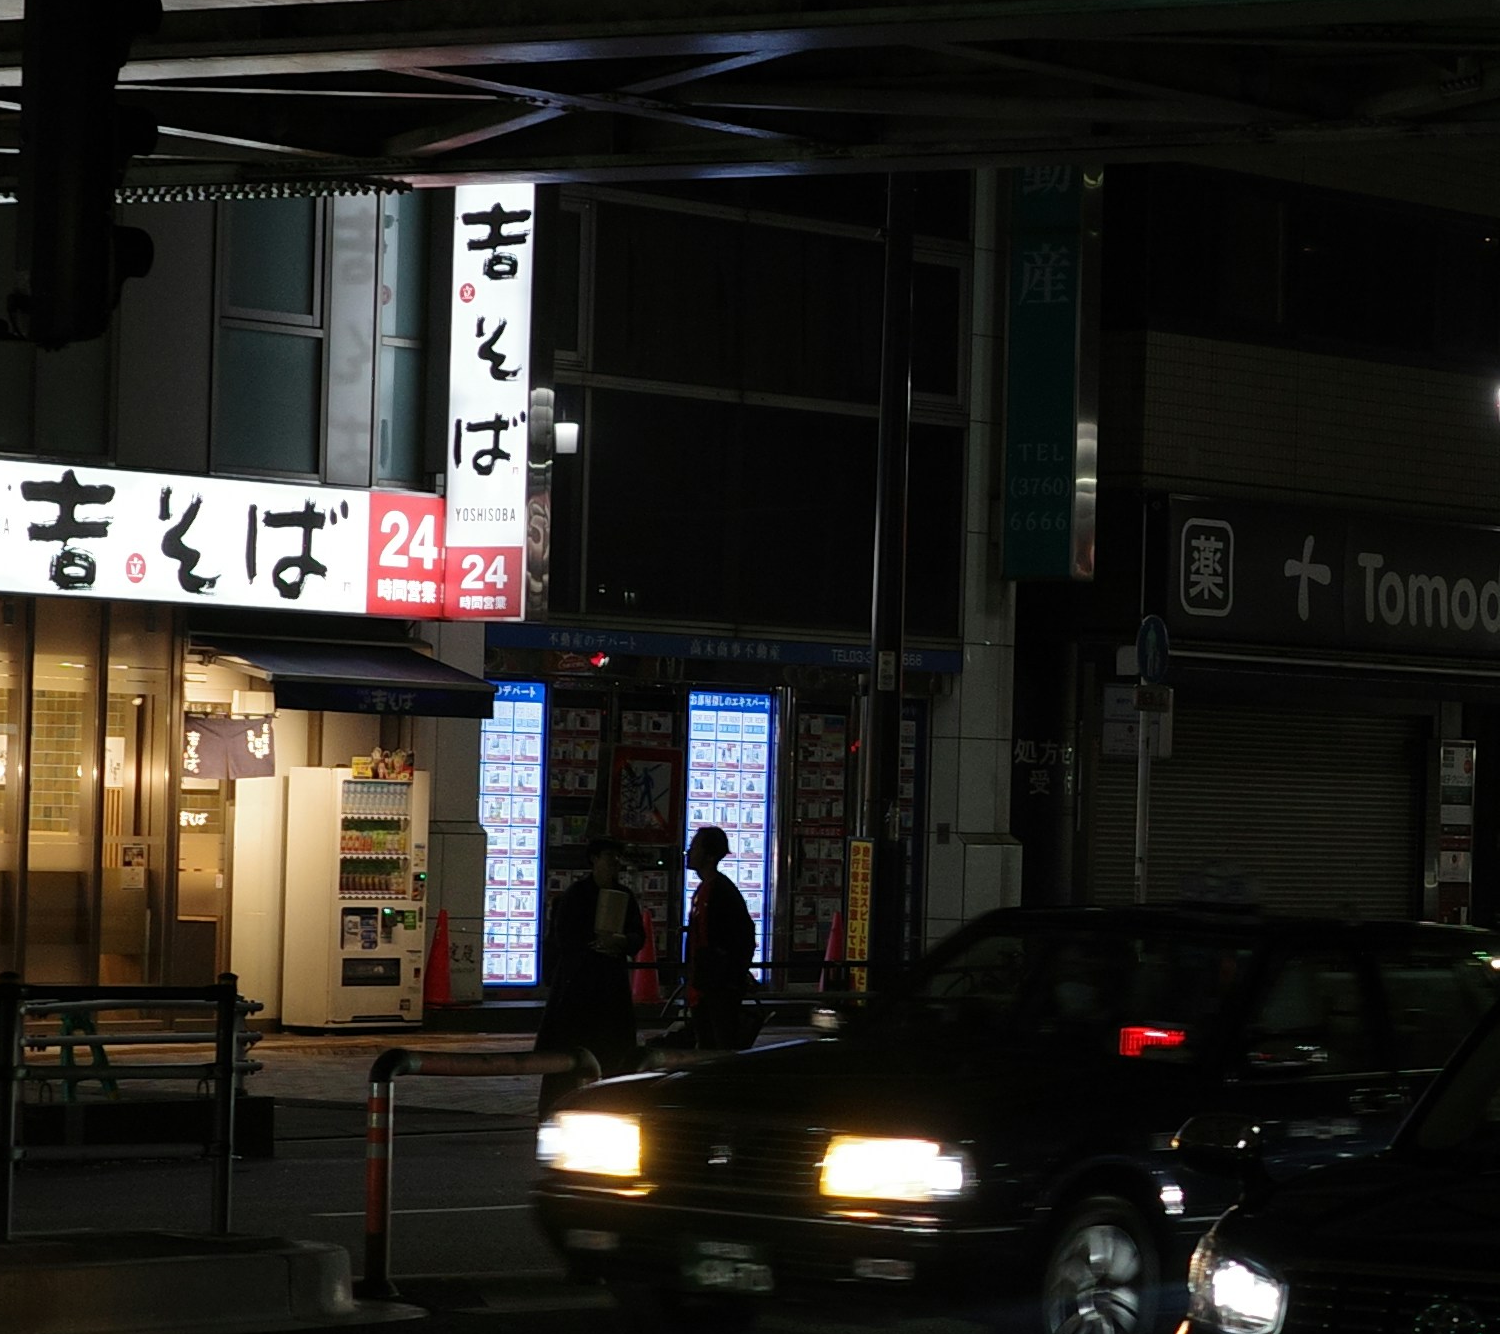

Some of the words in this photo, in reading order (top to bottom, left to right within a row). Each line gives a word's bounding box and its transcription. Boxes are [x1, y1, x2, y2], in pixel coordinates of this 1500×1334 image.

[453, 202, 532, 476] 吉そば
[1017, 443, 1064, 462] TEL
[1010, 475, 1070, 498] (3760)
[455, 506, 516, 523] YOSHISOBA
[1010, 511, 1067, 531] 6666
[20, 469, 349, 600] 吉そば
[379, 510, 438, 569] 24
[460, 554, 508, 589] 24
[1189, 535, 1224, 600] 薬
[377, 577, 437, 604] 時間営業
[459, 594, 507, 611] 時間営業
[547, 631, 638, 650] 不動産のデパート
